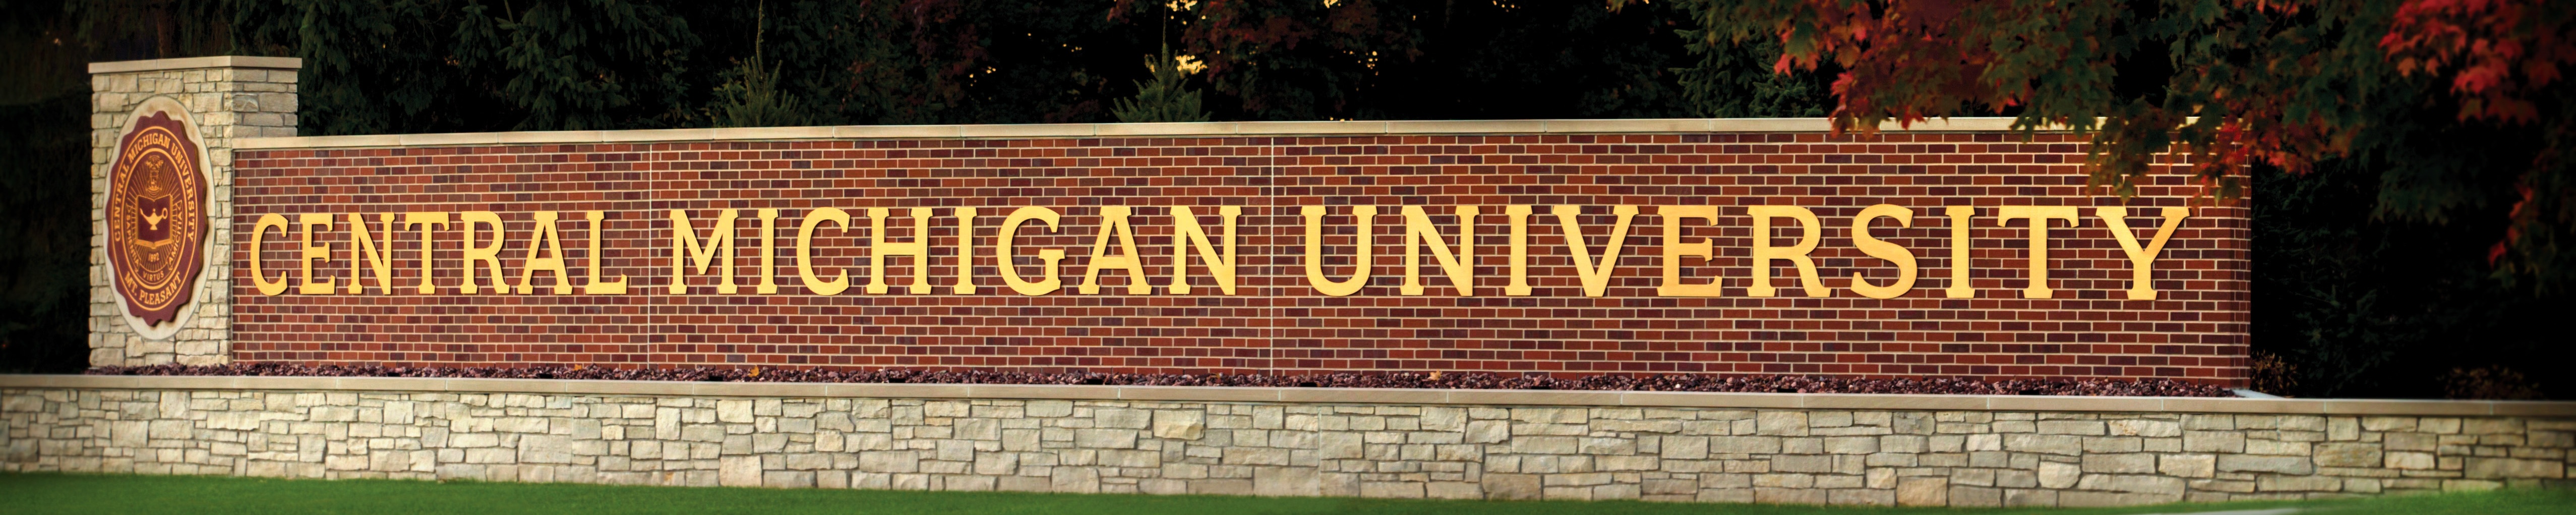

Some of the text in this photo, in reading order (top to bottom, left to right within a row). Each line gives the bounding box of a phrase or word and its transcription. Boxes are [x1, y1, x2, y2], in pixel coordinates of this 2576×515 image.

[114, 133, 195, 242] CENTRAL MICHIGAN UNIVERSITY
[143, 270, 164, 281] VIRTUS
[168, 212, 183, 265] AMICITIA
[148, 252, 160, 262] 1892
[250, 203, 2190, 301] CENTRAL MICHIGAN UNIVERSITY
[125, 271, 182, 305] MT. PLEASANT
